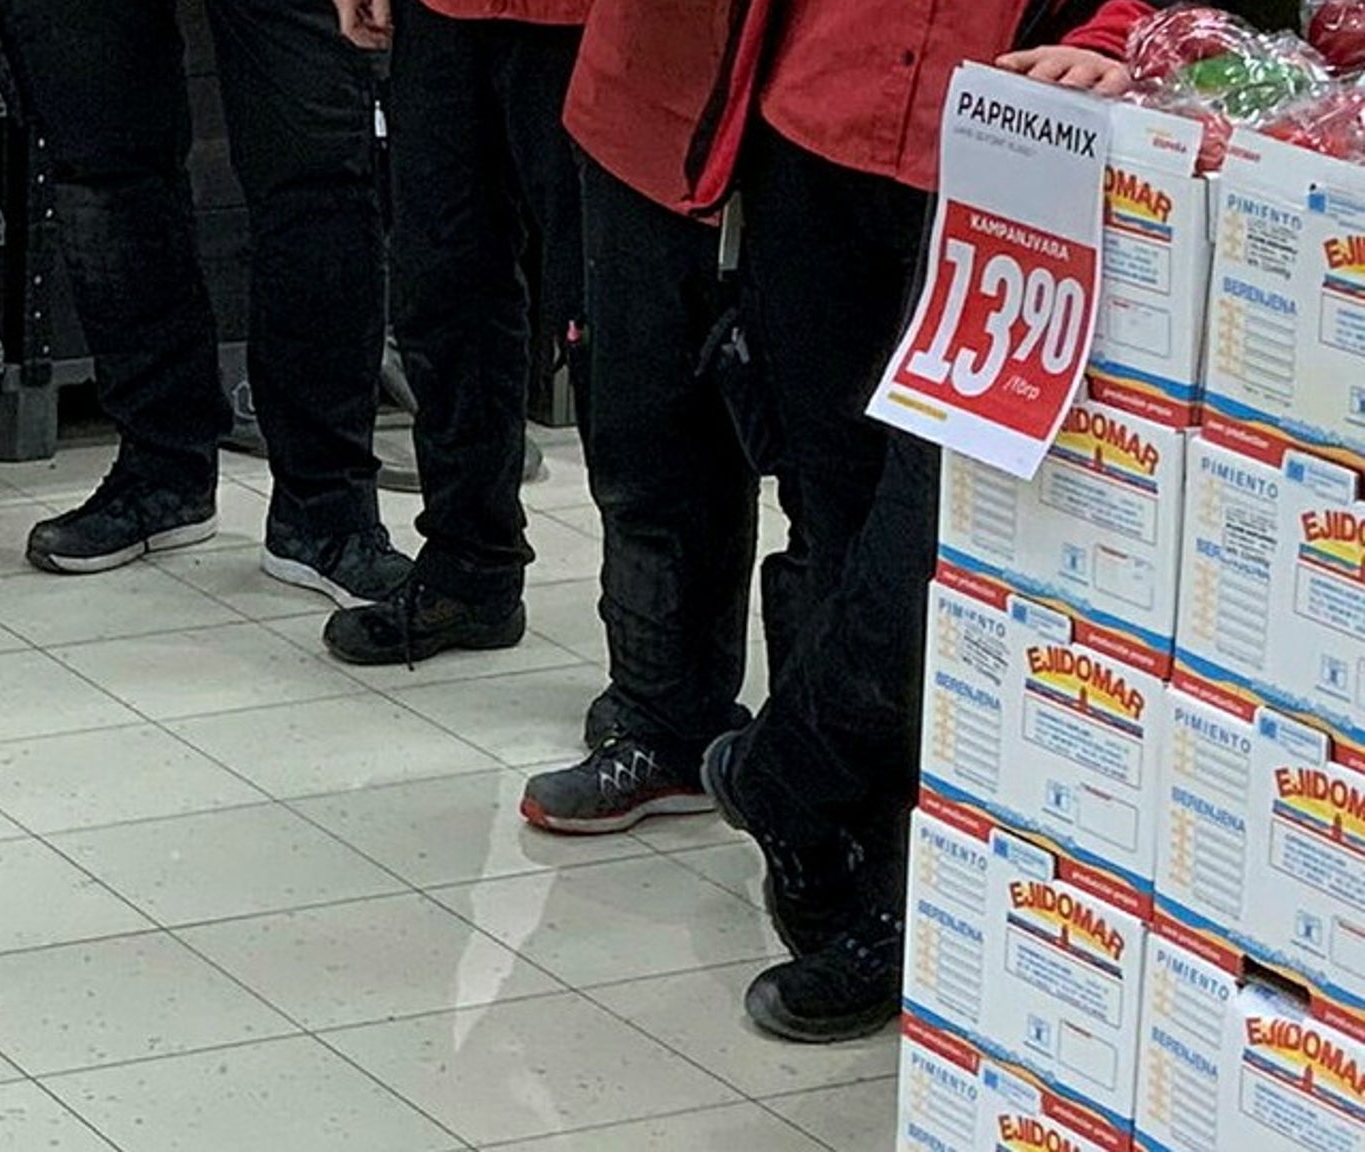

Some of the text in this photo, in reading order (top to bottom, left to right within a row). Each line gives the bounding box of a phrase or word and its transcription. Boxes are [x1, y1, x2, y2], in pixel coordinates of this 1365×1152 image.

[957, 91, 1098, 159] PAPRIKAMIX
[1227, 193, 1303, 231] PIMIENTO
[969, 213, 1070, 261] KAMPANJVARA
[1222, 276, 1298, 315] BERENJENA
[1201, 457, 1279, 499] PIMIENTO
[1300, 509, 1365, 548] EJID
[1026, 645, 1146, 721] EJIDOMAR
[1174, 707, 1252, 754] PIMIENTO
[1171, 786, 1247, 834] BERENJENA
[920, 826, 989, 872] PIMIENTO
[1009, 881, 1126, 961] EJIDOMAR
[1157, 950, 1230, 1002] PIMIENTO
[911, 1051, 978, 1102] PIMIENTO
